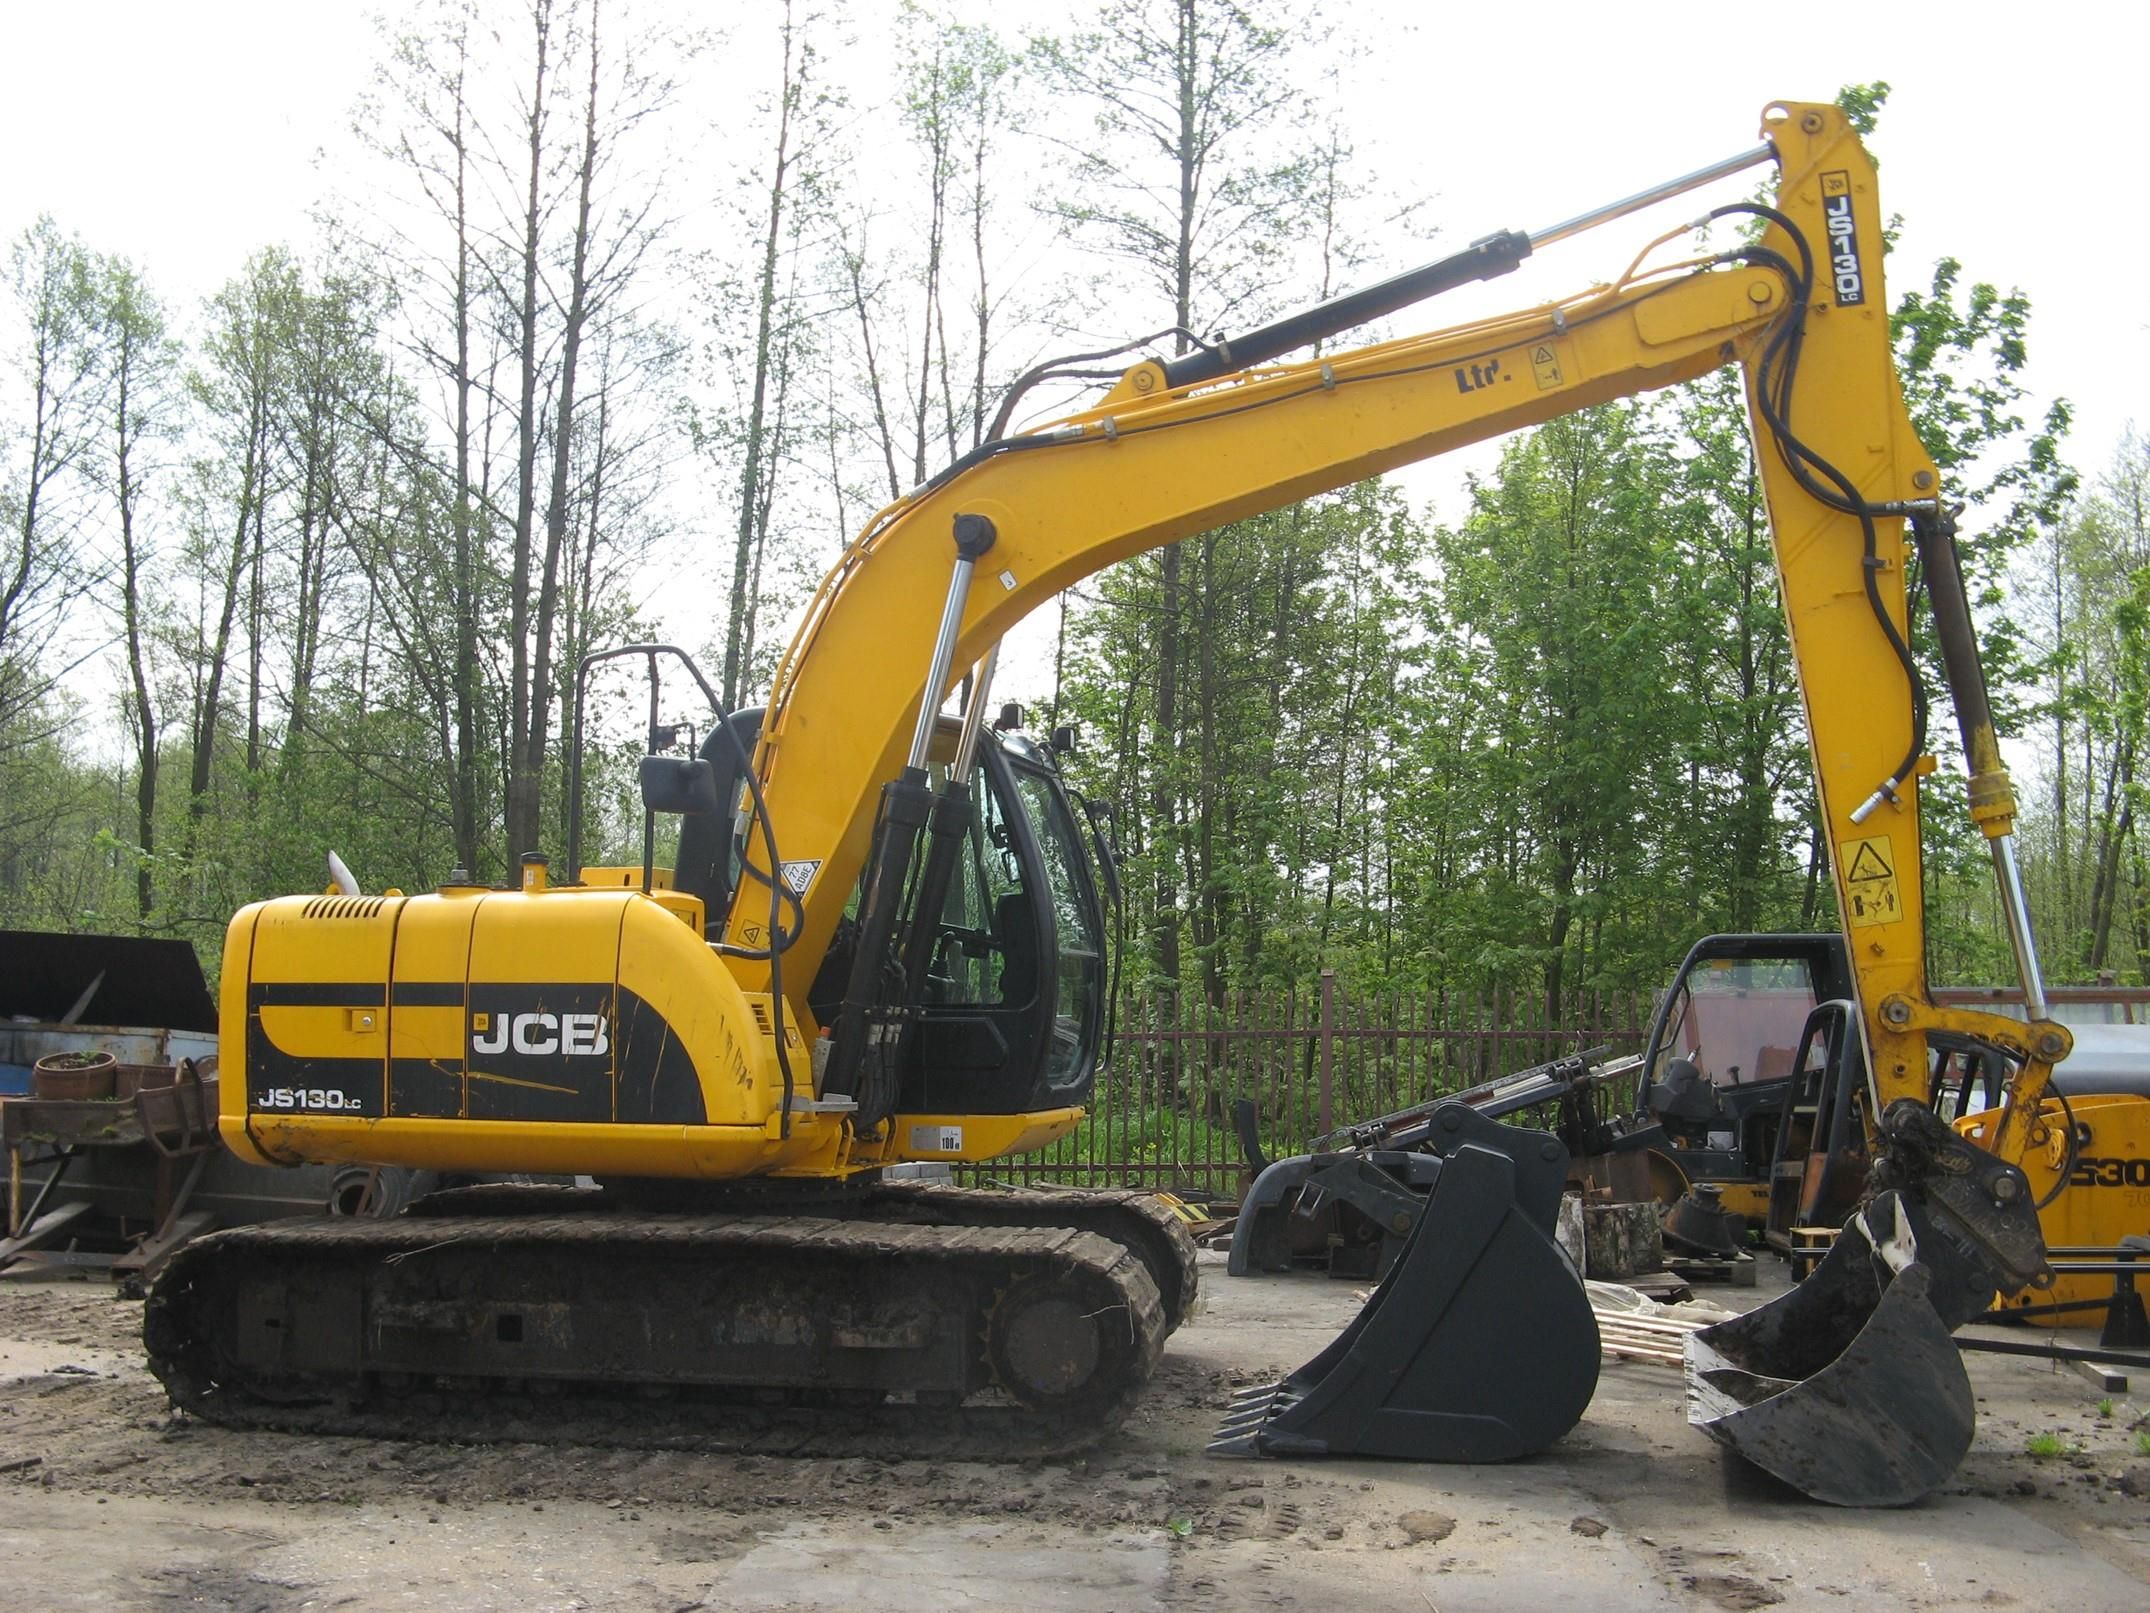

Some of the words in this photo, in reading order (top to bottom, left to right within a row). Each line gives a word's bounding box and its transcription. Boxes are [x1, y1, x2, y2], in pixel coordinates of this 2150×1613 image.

[789, 865, 799, 879] 77
[473, 1012, 608, 1055] JCB
[942, 1136, 954, 1150] 100
